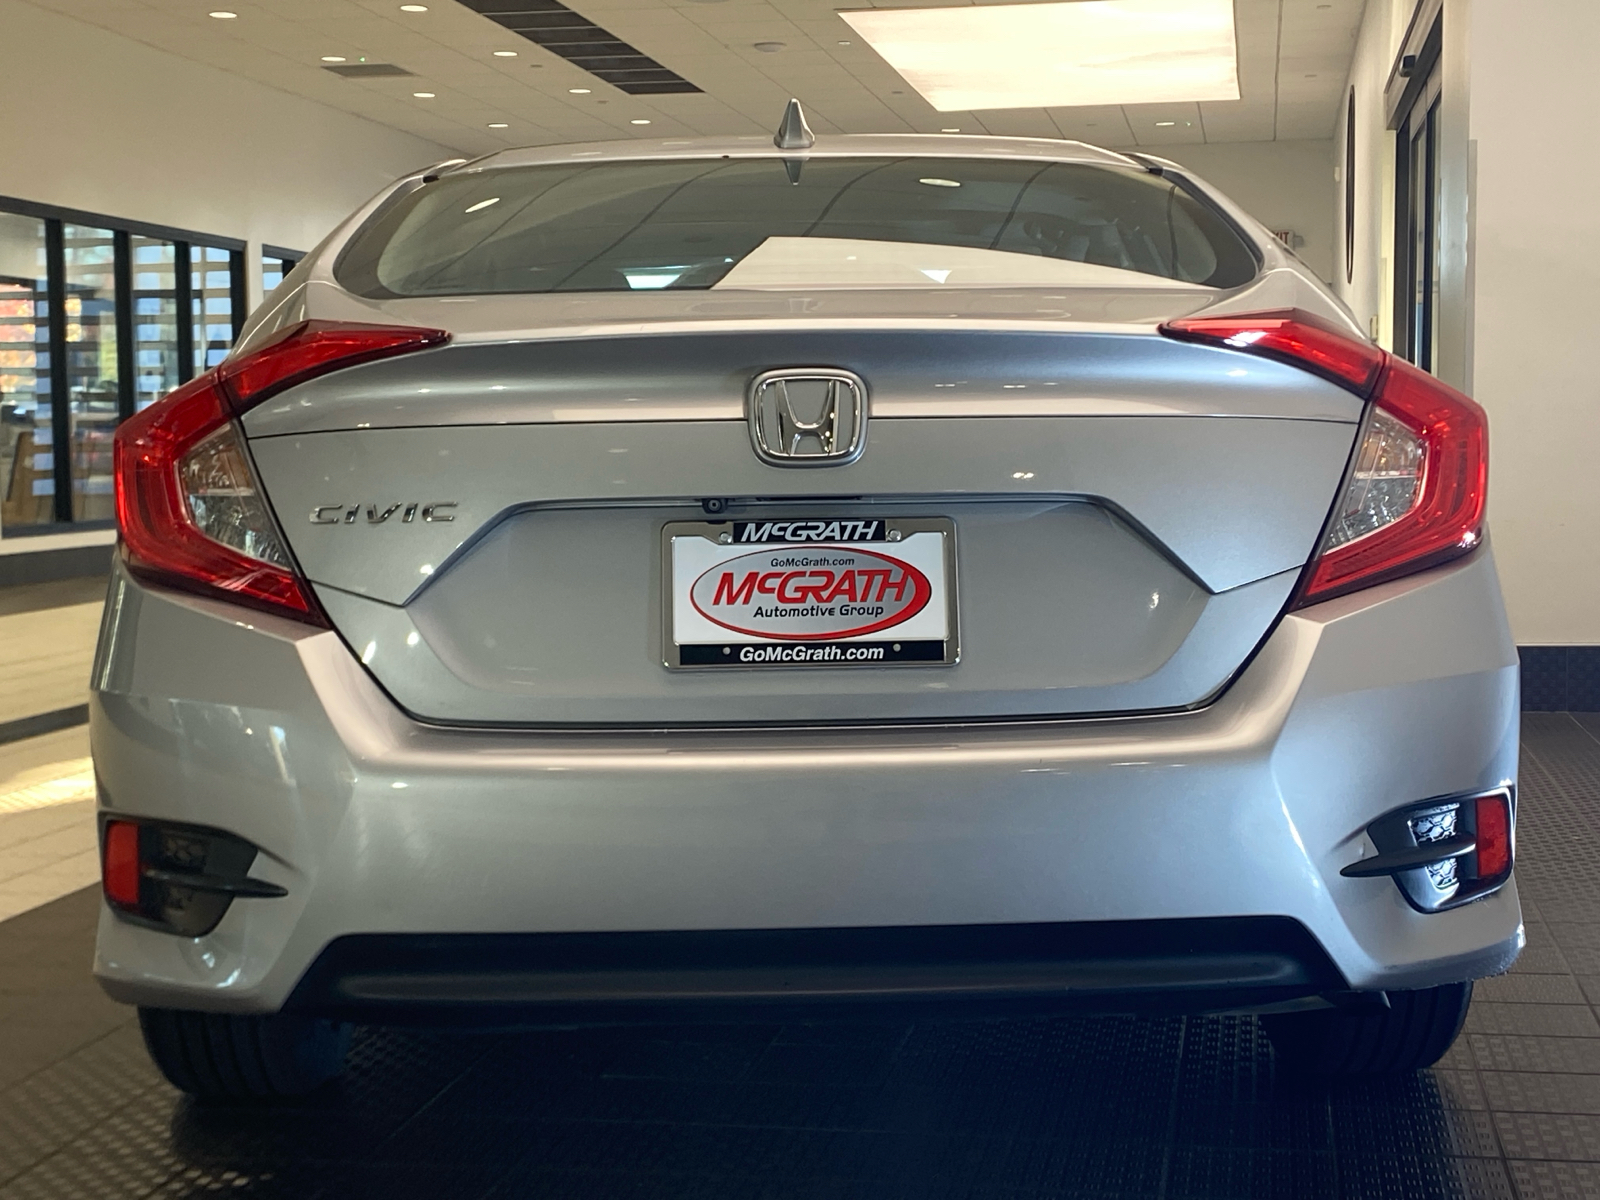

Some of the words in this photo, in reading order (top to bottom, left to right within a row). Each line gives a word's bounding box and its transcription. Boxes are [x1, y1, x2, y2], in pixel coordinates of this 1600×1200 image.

[309, 501, 458, 524] CIVIC
[770, 557, 855, 568] GoMcGrath.com
[753, 605, 835, 618] Automotive
[839, 604, 884, 617] Group
[739, 646, 884, 662] GoMcGrath.com
